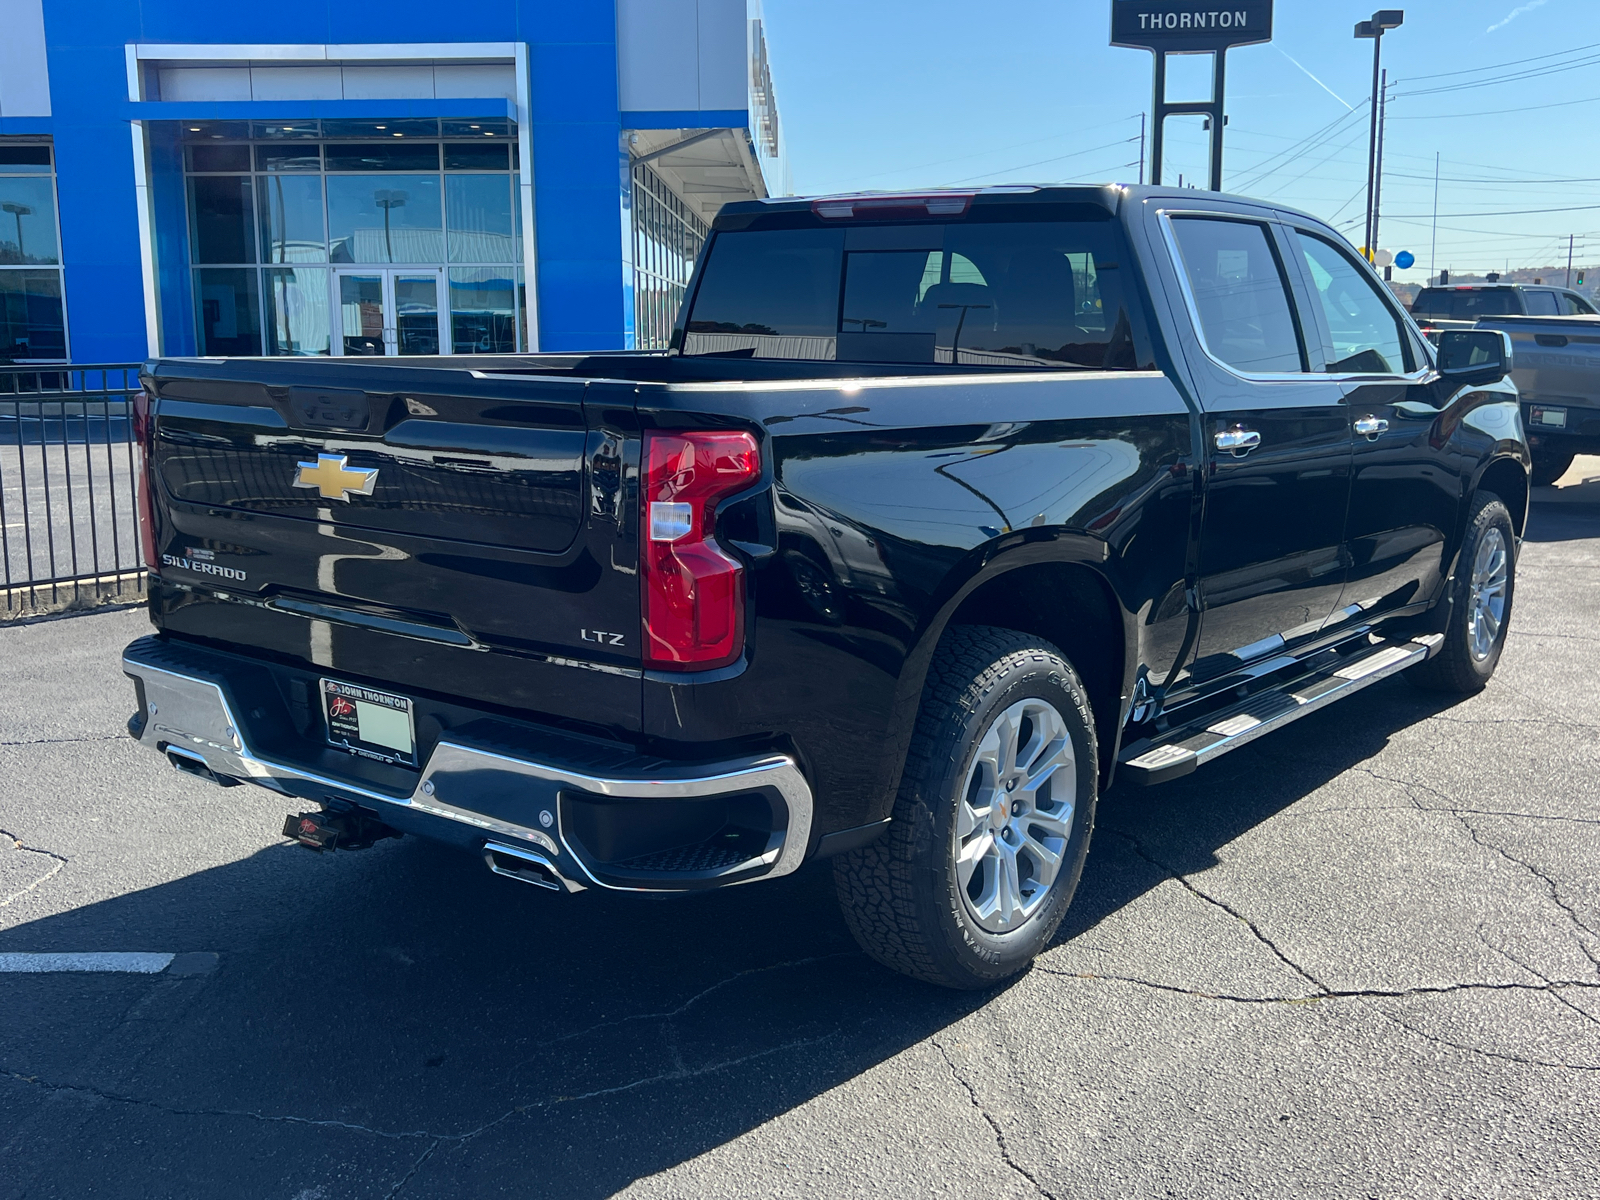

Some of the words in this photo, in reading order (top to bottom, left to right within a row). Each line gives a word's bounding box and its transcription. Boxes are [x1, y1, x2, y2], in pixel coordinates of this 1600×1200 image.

[1138, 11, 1247, 29] THORNTON
[162, 554, 247, 581] SILVERADO
[580, 628, 625, 647] LTZ
[341, 685, 362, 698] JOHN
[362, 690, 407, 709] THORNTON
